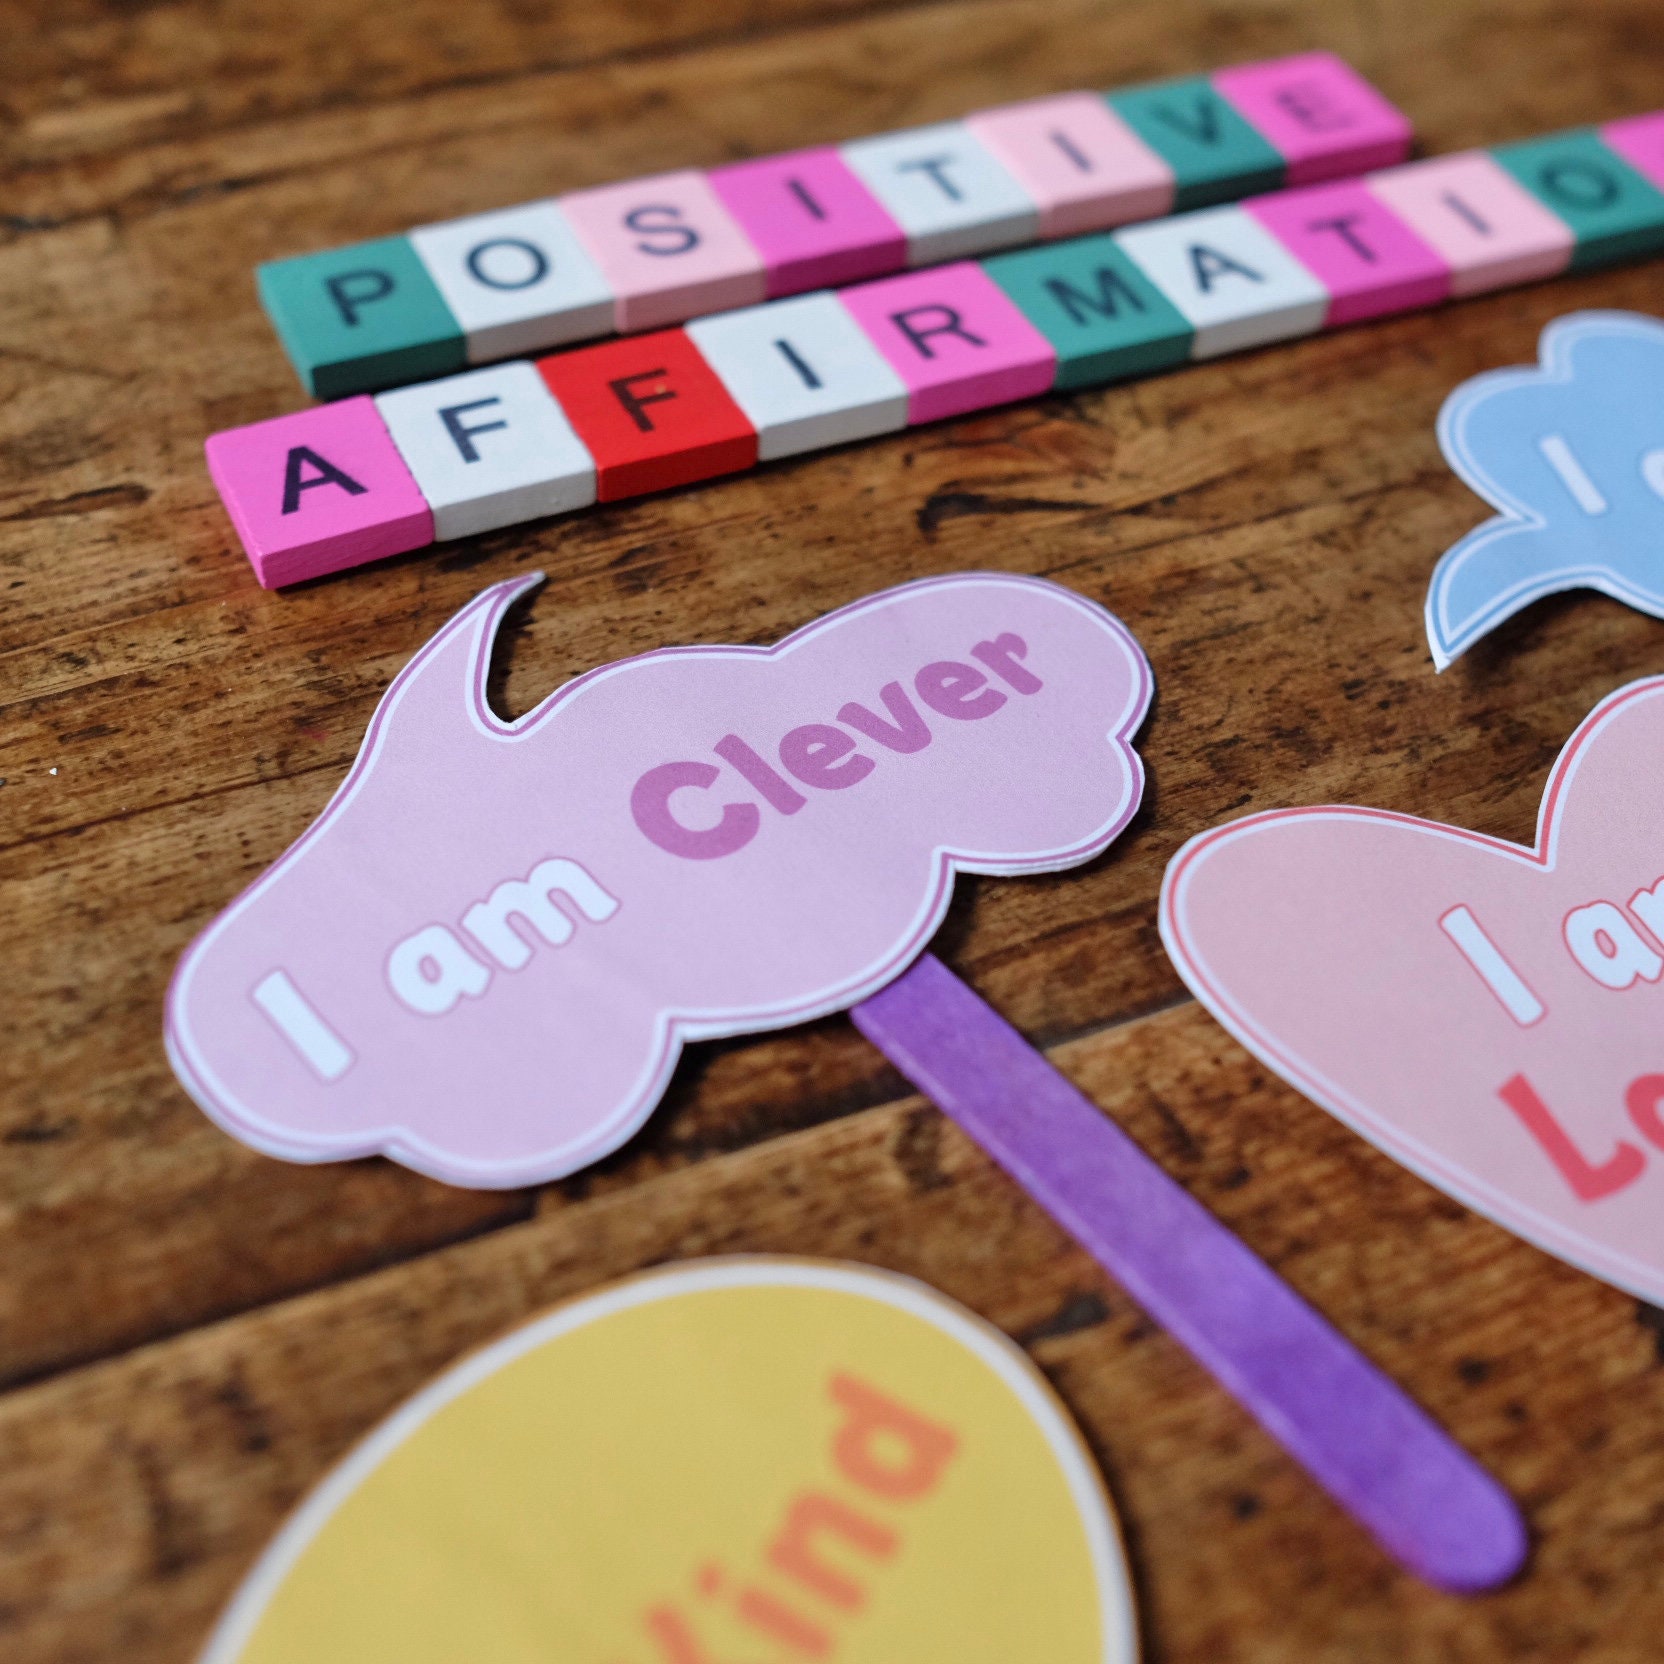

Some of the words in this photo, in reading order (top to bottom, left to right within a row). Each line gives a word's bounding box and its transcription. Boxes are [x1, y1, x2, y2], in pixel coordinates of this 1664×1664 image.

[323, 82, 1354, 328] POSITIVE
[1537, 434, 1609, 516] I
[252, 969, 353, 1083] I
[385, 857, 622, 1017] am
[629, 632, 1044, 861] Clever
[1438, 903, 1549, 1027] I
[1561, 875, 1664, 991] a
